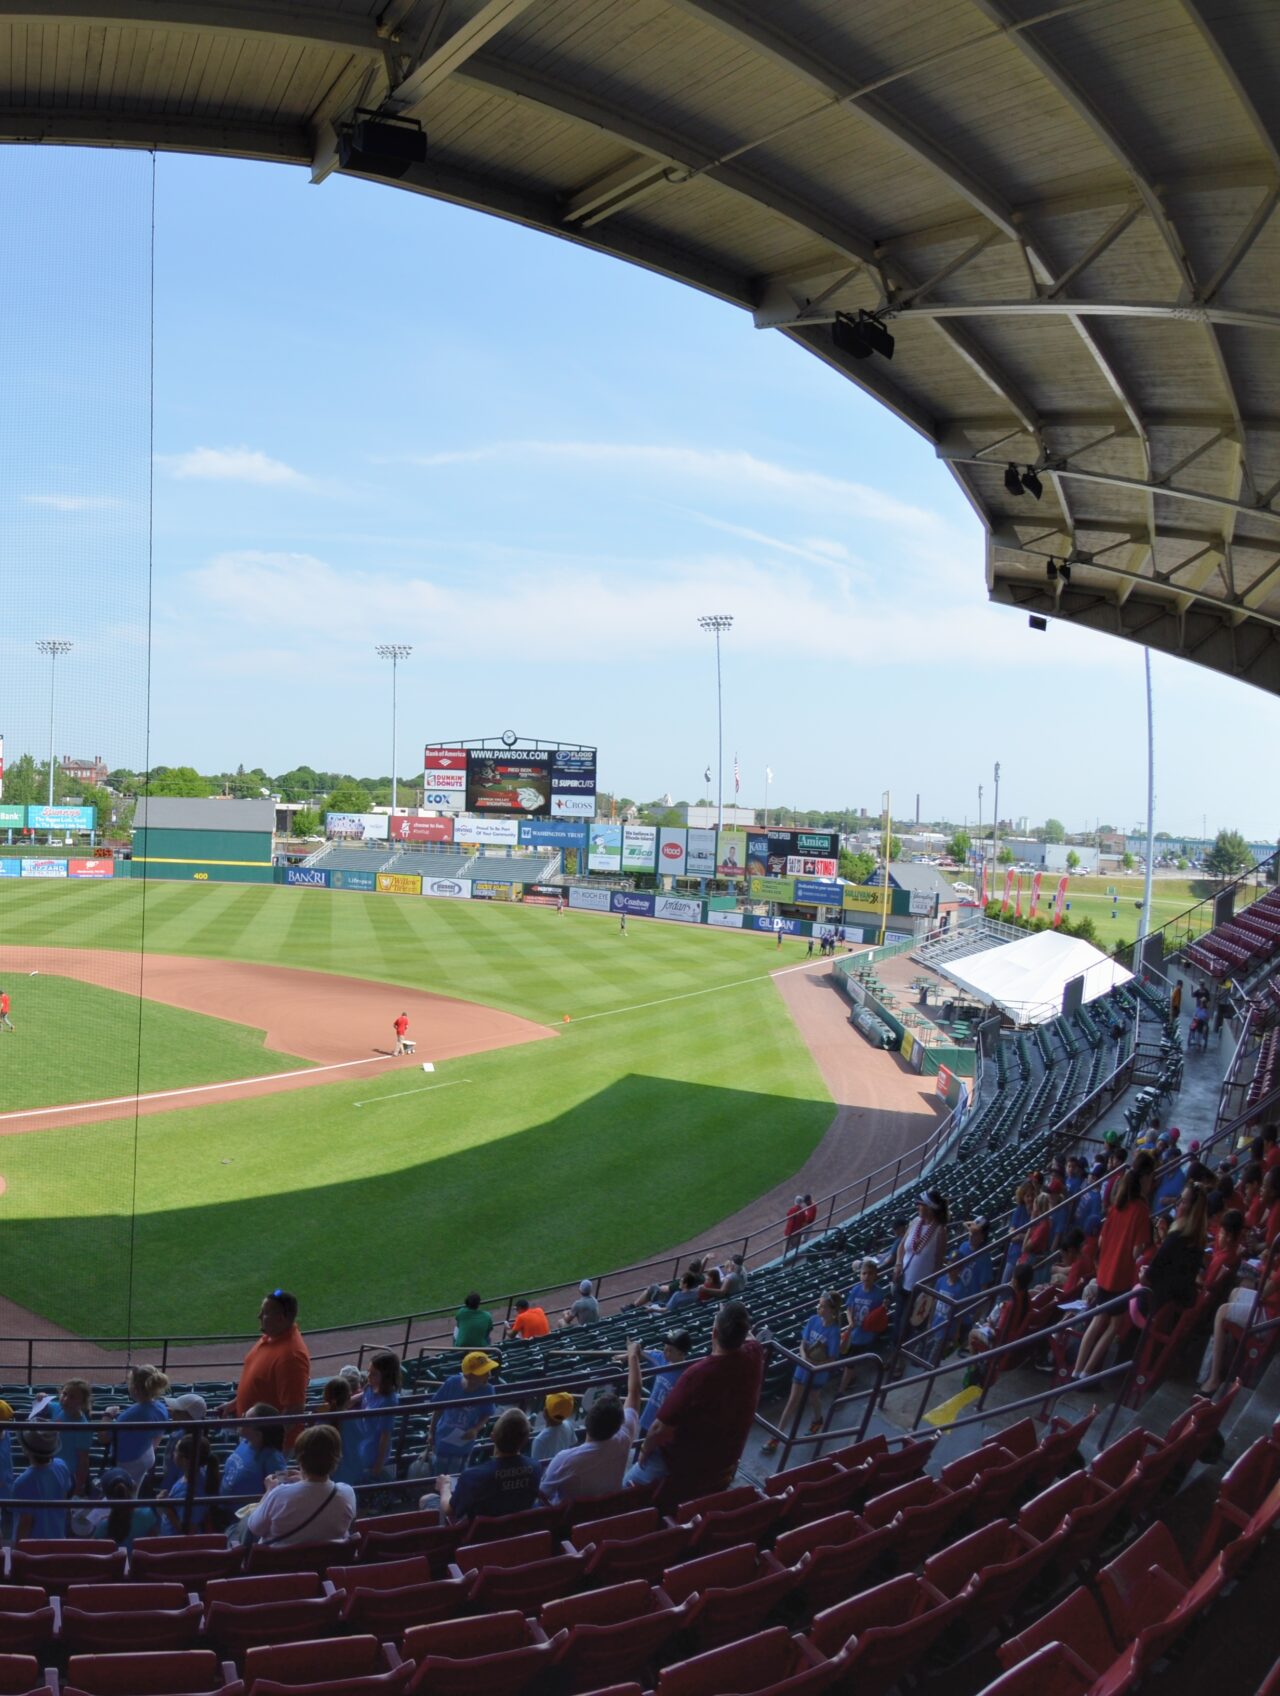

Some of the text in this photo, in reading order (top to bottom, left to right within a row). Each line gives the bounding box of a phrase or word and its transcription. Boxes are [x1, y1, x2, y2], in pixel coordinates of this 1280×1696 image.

[470, 750, 548, 760] WWW.PAWSOX.COM
[558, 780, 594, 788] SUPERCUTS
[426, 794, 450, 804] COX
[0, 812, 19, 820] Bank
[780, 832, 790, 840] SPEED
[799, 836, 828, 848] Amica
[664, 846, 681, 855] Hood
[749, 842, 768, 853] KAYE
[816, 860, 835, 876] STING!
[194, 872, 208, 880] 400
[582, 891, 598, 899] KOCH
[624, 897, 650, 908] Coastway
[660, 899, 691, 912] Jordan's
[759, 918, 794, 930] GILDAN
[916, 1300, 927, 1318] 4
[502, 1478, 530, 1491] SELECT
